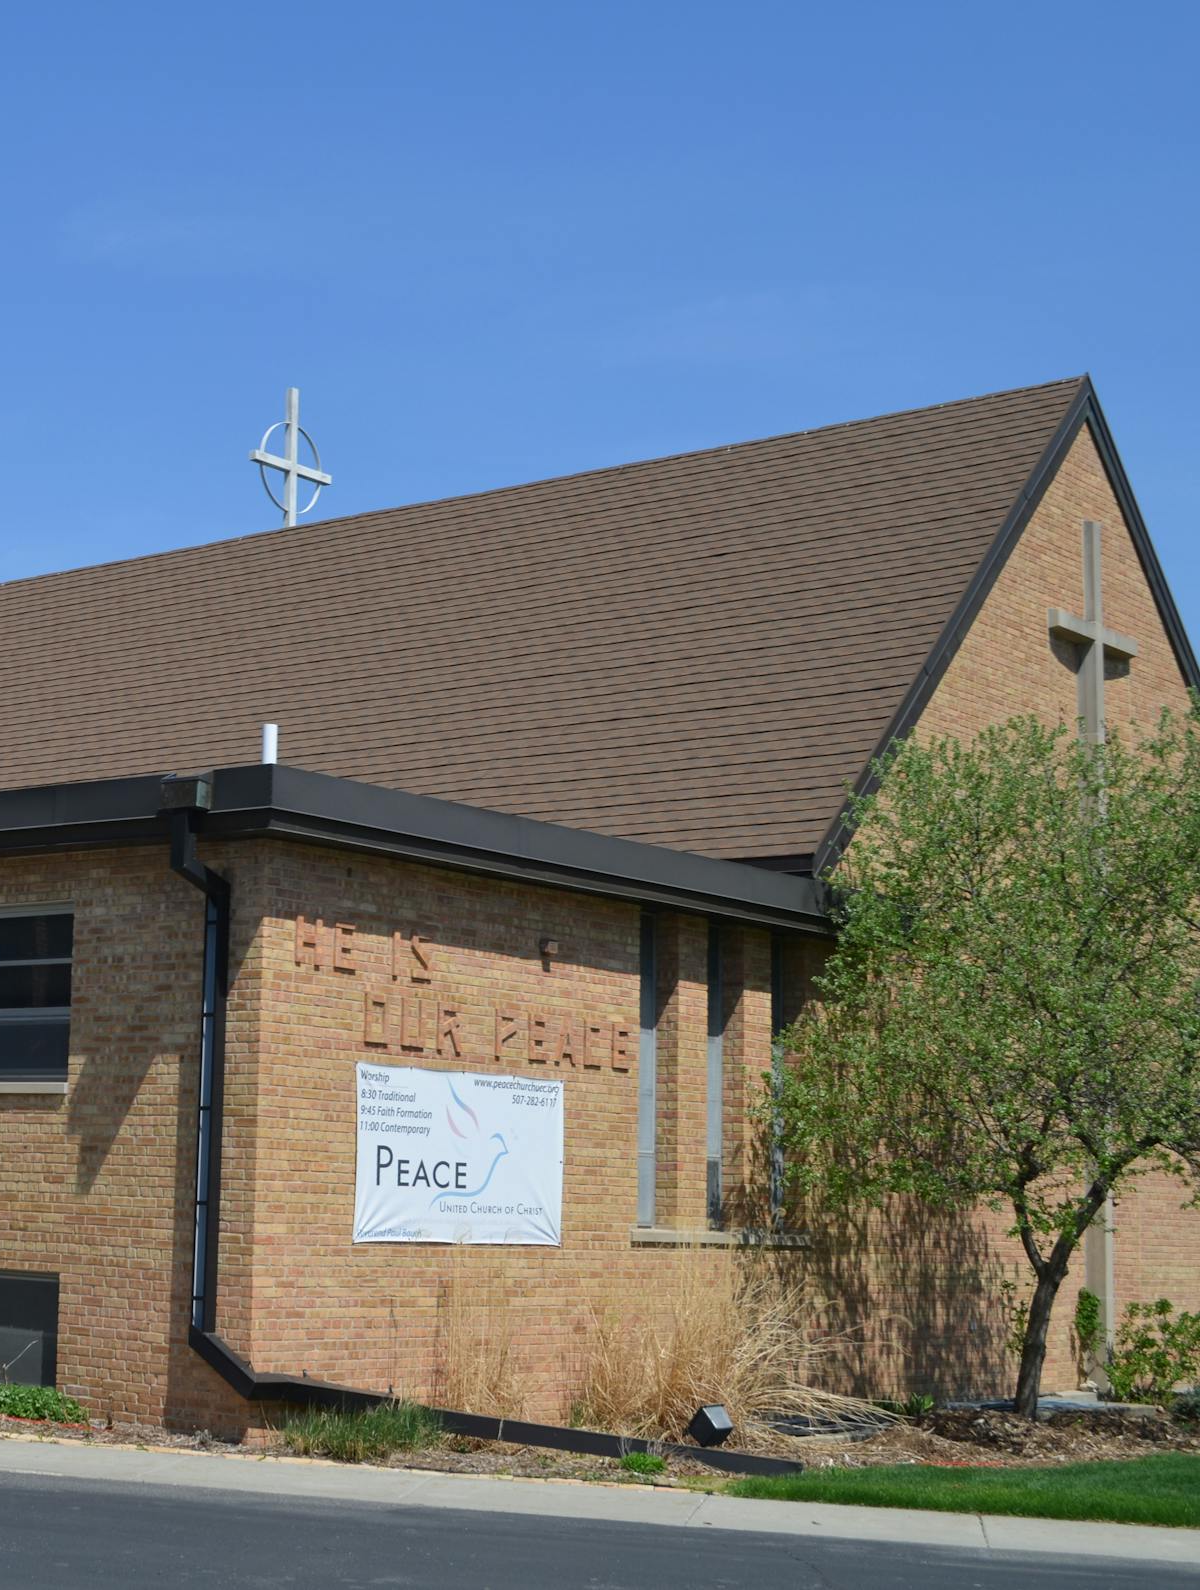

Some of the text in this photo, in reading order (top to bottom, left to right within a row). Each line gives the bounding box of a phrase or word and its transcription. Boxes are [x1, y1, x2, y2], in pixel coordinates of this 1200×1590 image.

[363, 990, 631, 1073] OUR PEACE
[360, 1069, 390, 1084] Worship
[360, 1088, 416, 1103] 8:30 Traditional
[360, 1105, 433, 1120] 9:45 Faith Formation
[360, 1121, 431, 1137] 11:00 Contemporary
[376, 1145, 468, 1189] PEACE
[439, 1201, 468, 1214] UNITED
[470, 1201, 502, 1215] CHURCH
[516, 1203, 543, 1216] CHRIST
